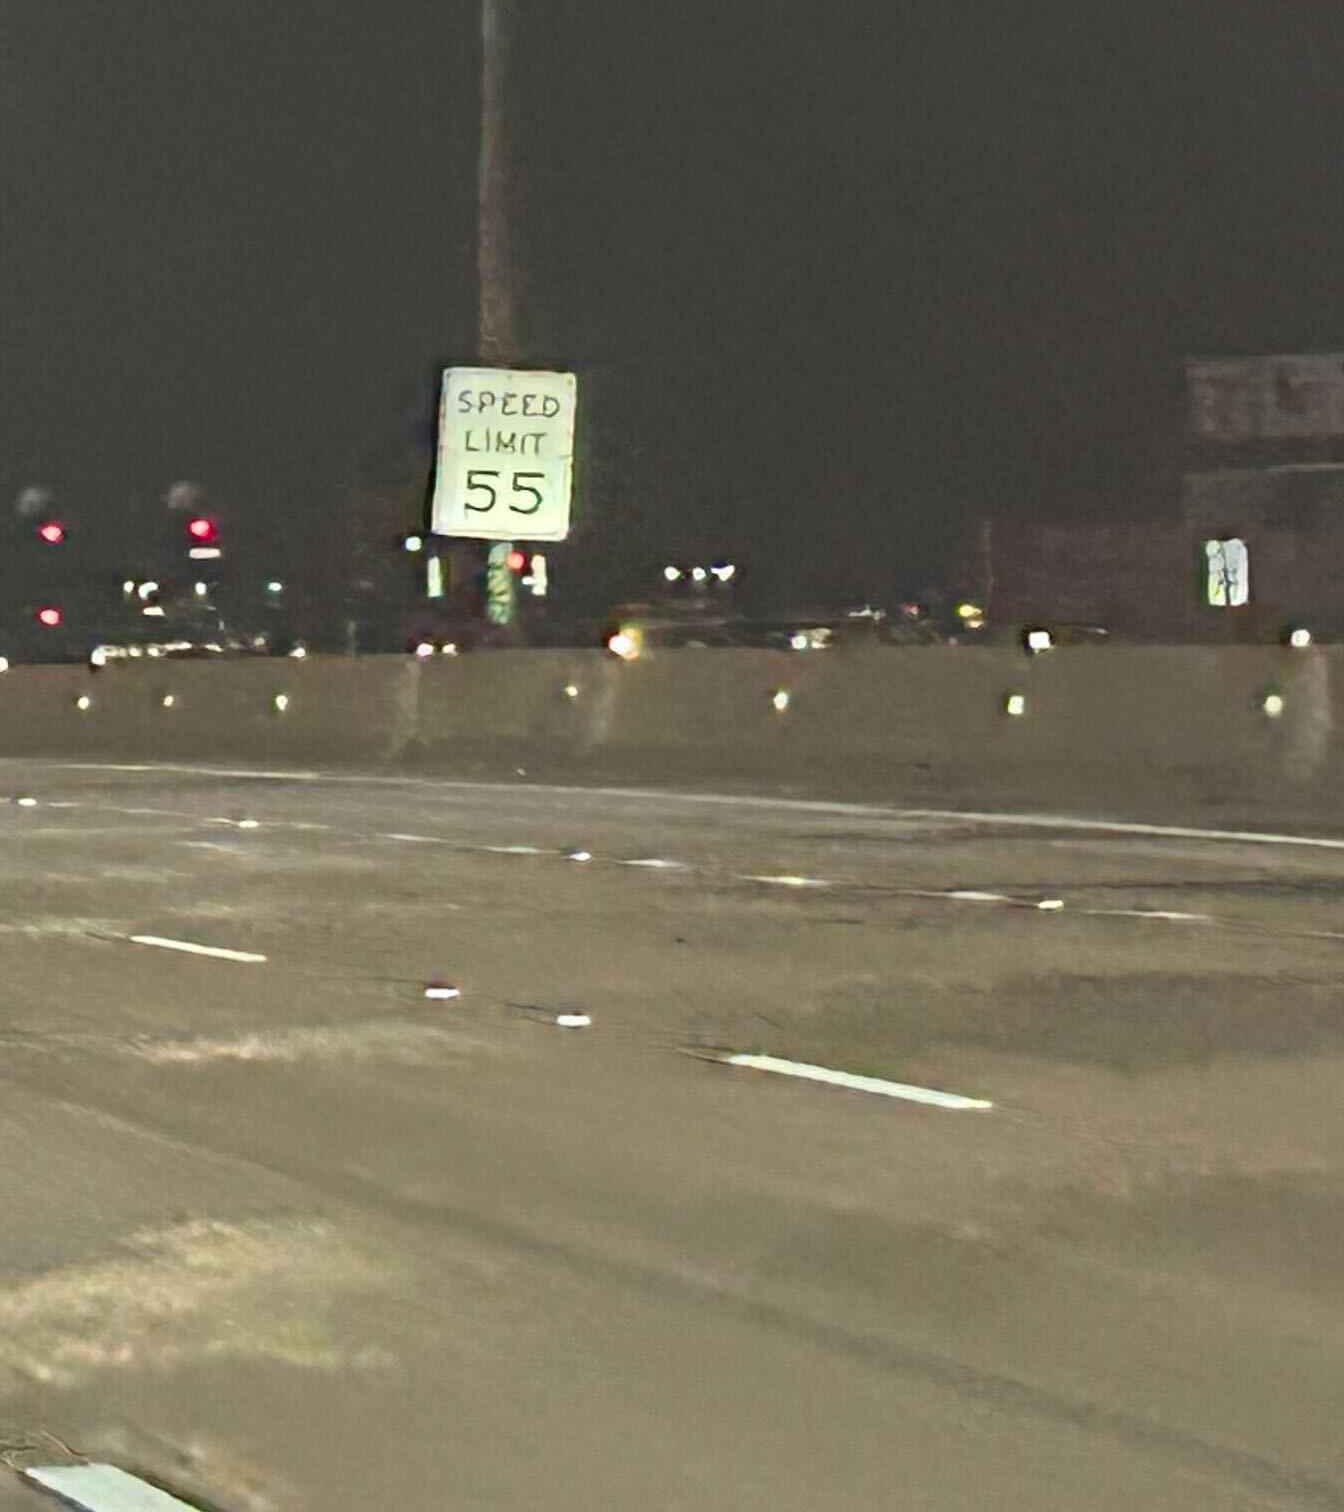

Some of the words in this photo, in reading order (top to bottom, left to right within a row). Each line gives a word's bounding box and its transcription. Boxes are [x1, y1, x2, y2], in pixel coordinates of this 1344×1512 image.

[458, 390, 560, 418] SPEED
[464, 428, 547, 455] LIMIT
[464, 469, 545, 515] 55
